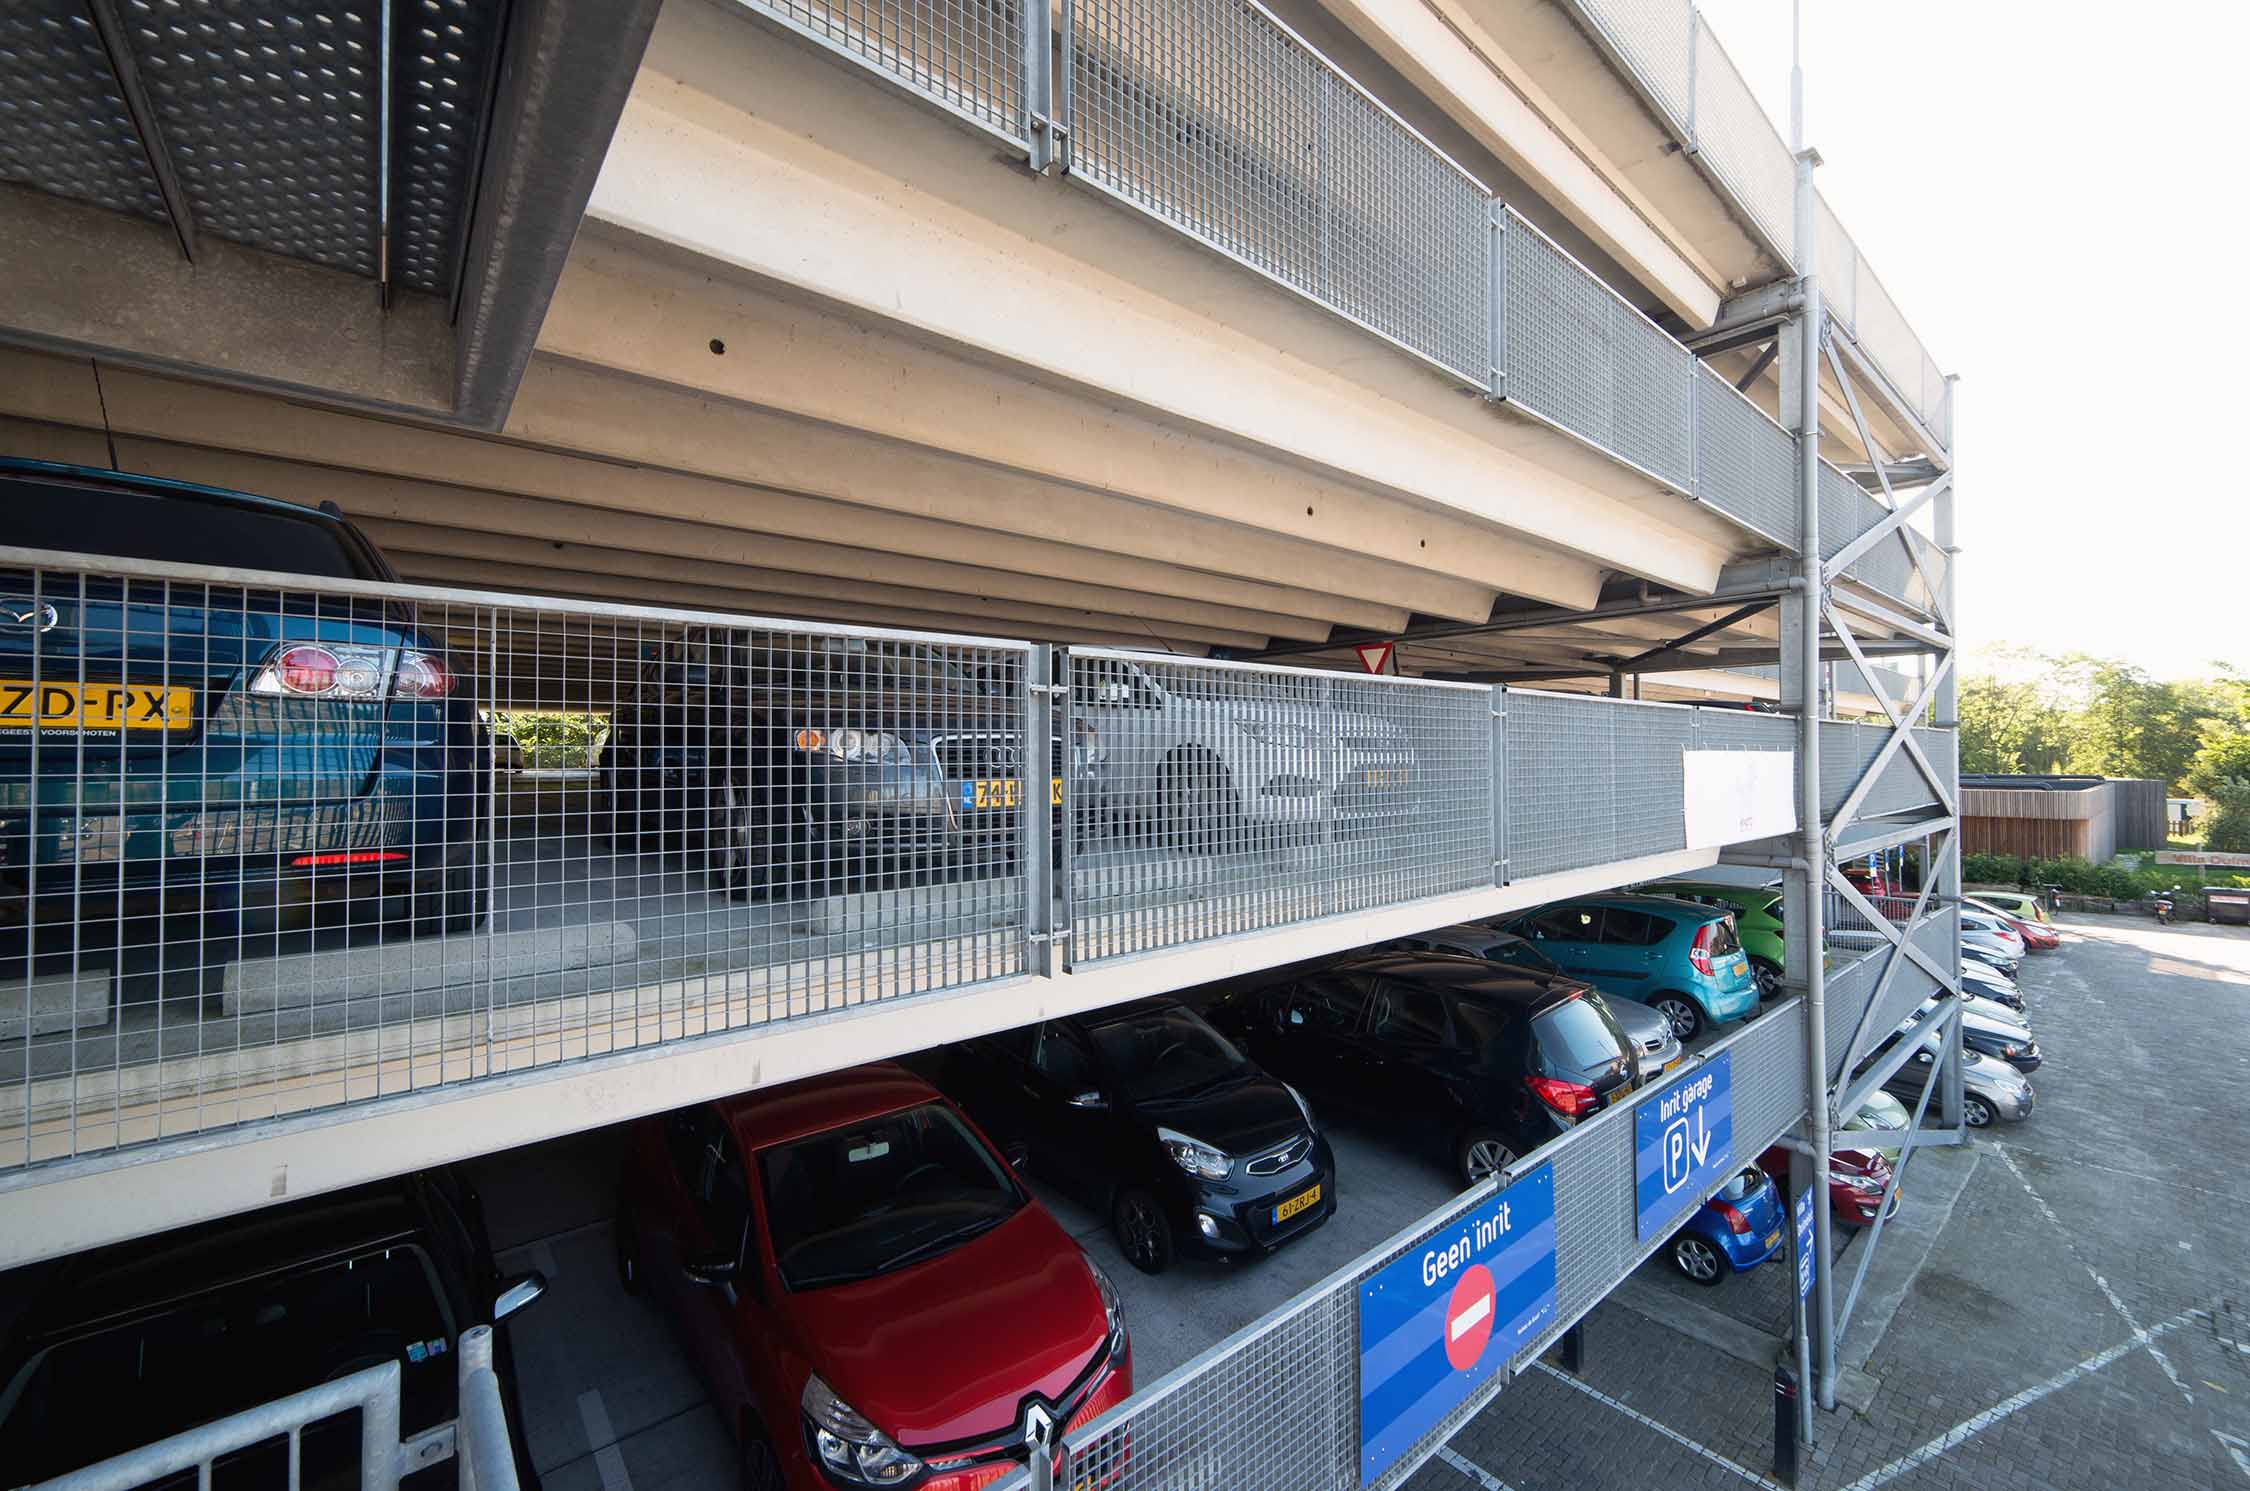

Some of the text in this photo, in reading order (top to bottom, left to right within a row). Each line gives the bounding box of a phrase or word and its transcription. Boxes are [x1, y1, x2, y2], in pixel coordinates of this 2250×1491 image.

[1661, 1090, 1681, 1123] Inrit
[1682, 1074, 1713, 1113] garage
[1671, 1132, 1683, 1179] P
[1423, 1201, 1512, 1287] Geen inrit
